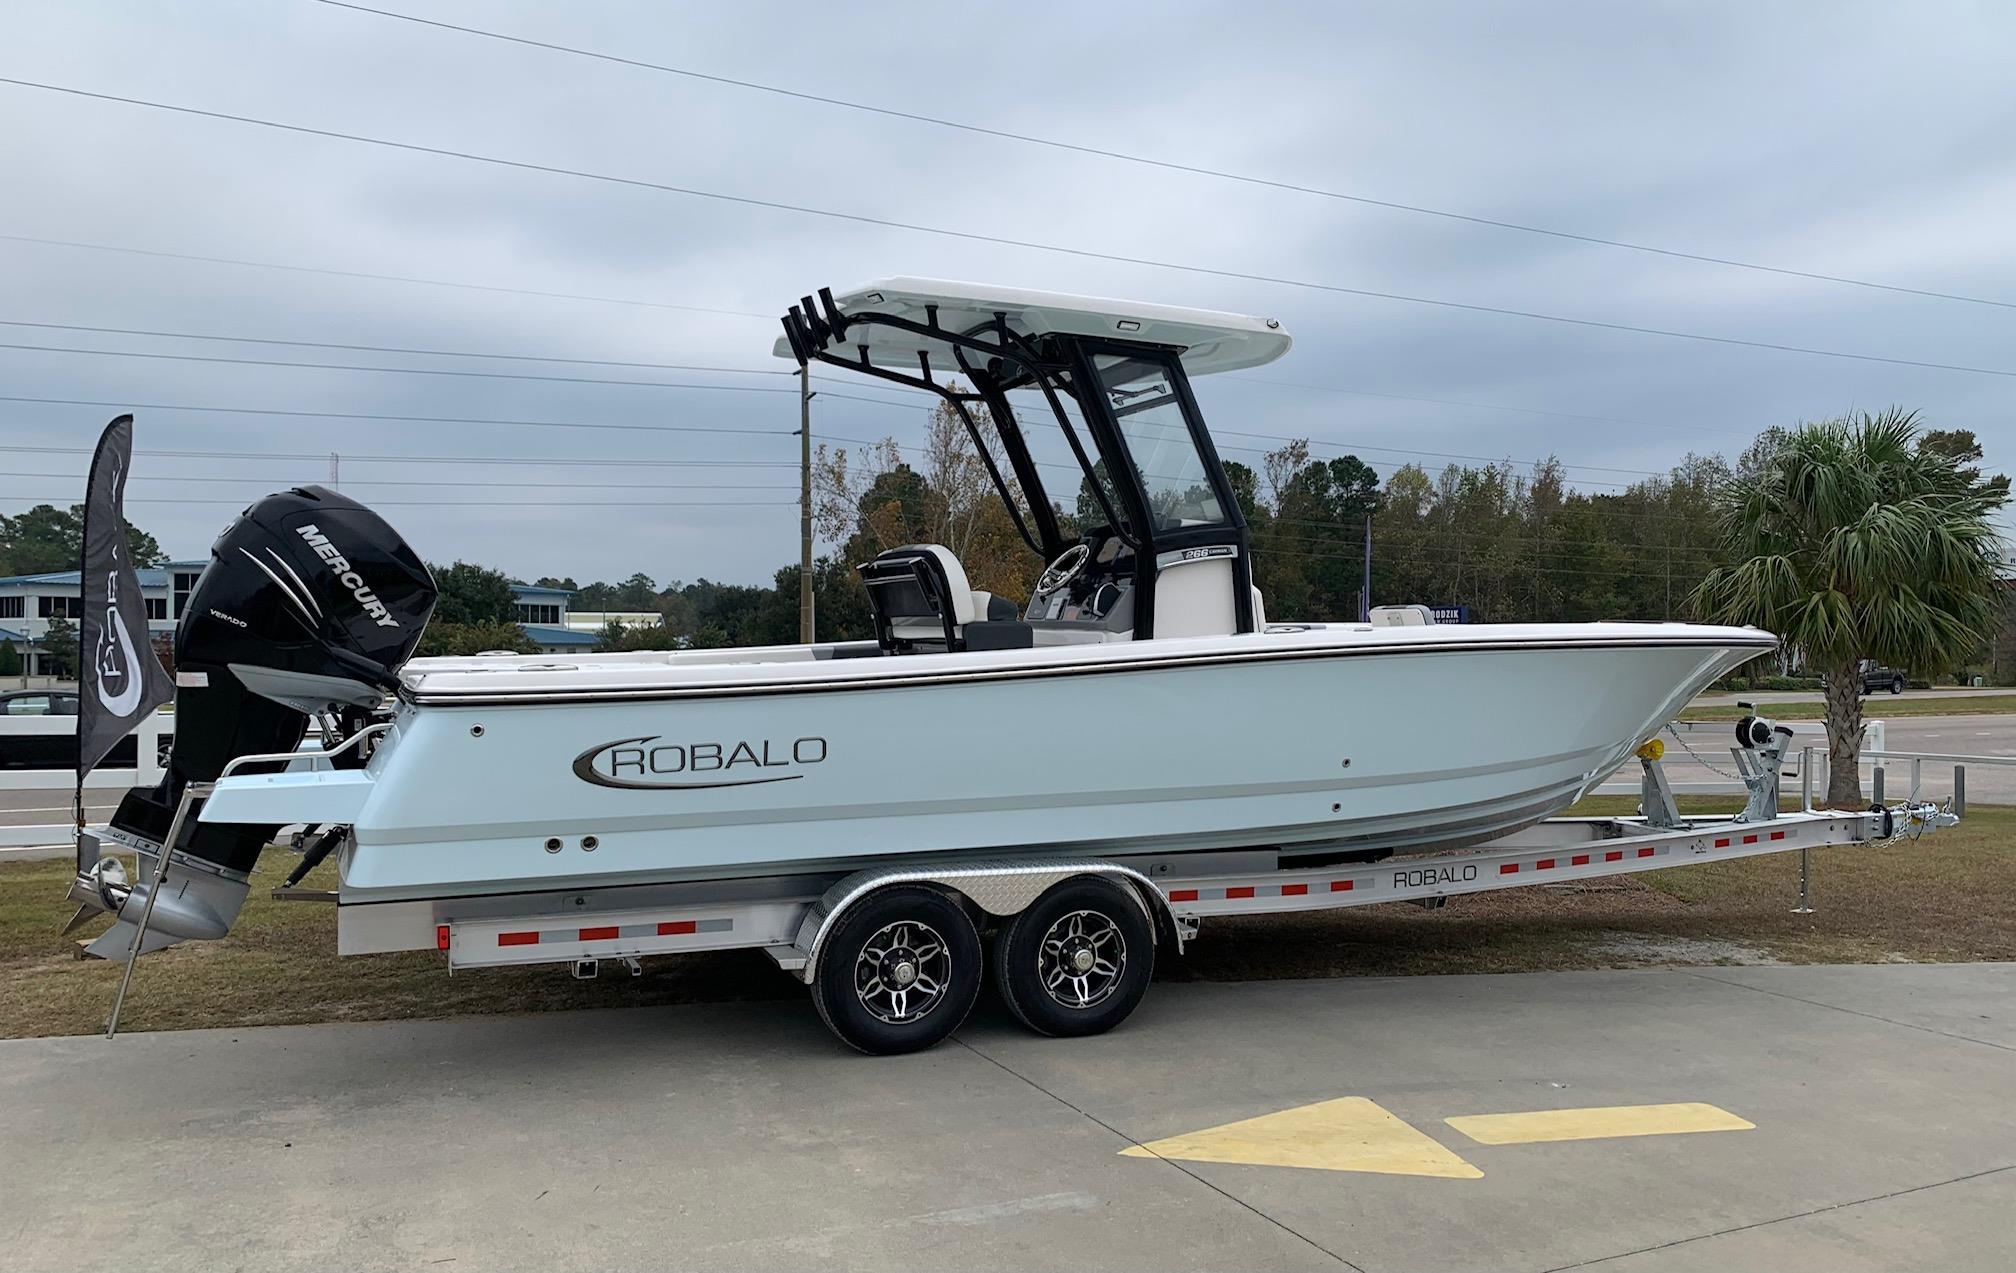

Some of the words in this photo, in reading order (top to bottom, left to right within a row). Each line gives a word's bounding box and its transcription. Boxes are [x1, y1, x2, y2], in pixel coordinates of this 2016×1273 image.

[1186, 549, 1209, 559] 266
[295, 524, 400, 628] MERCURY
[210, 608, 248, 628] VERADO
[611, 737, 827, 777] ROBALO
[1394, 865, 1477, 888] ROBALO
